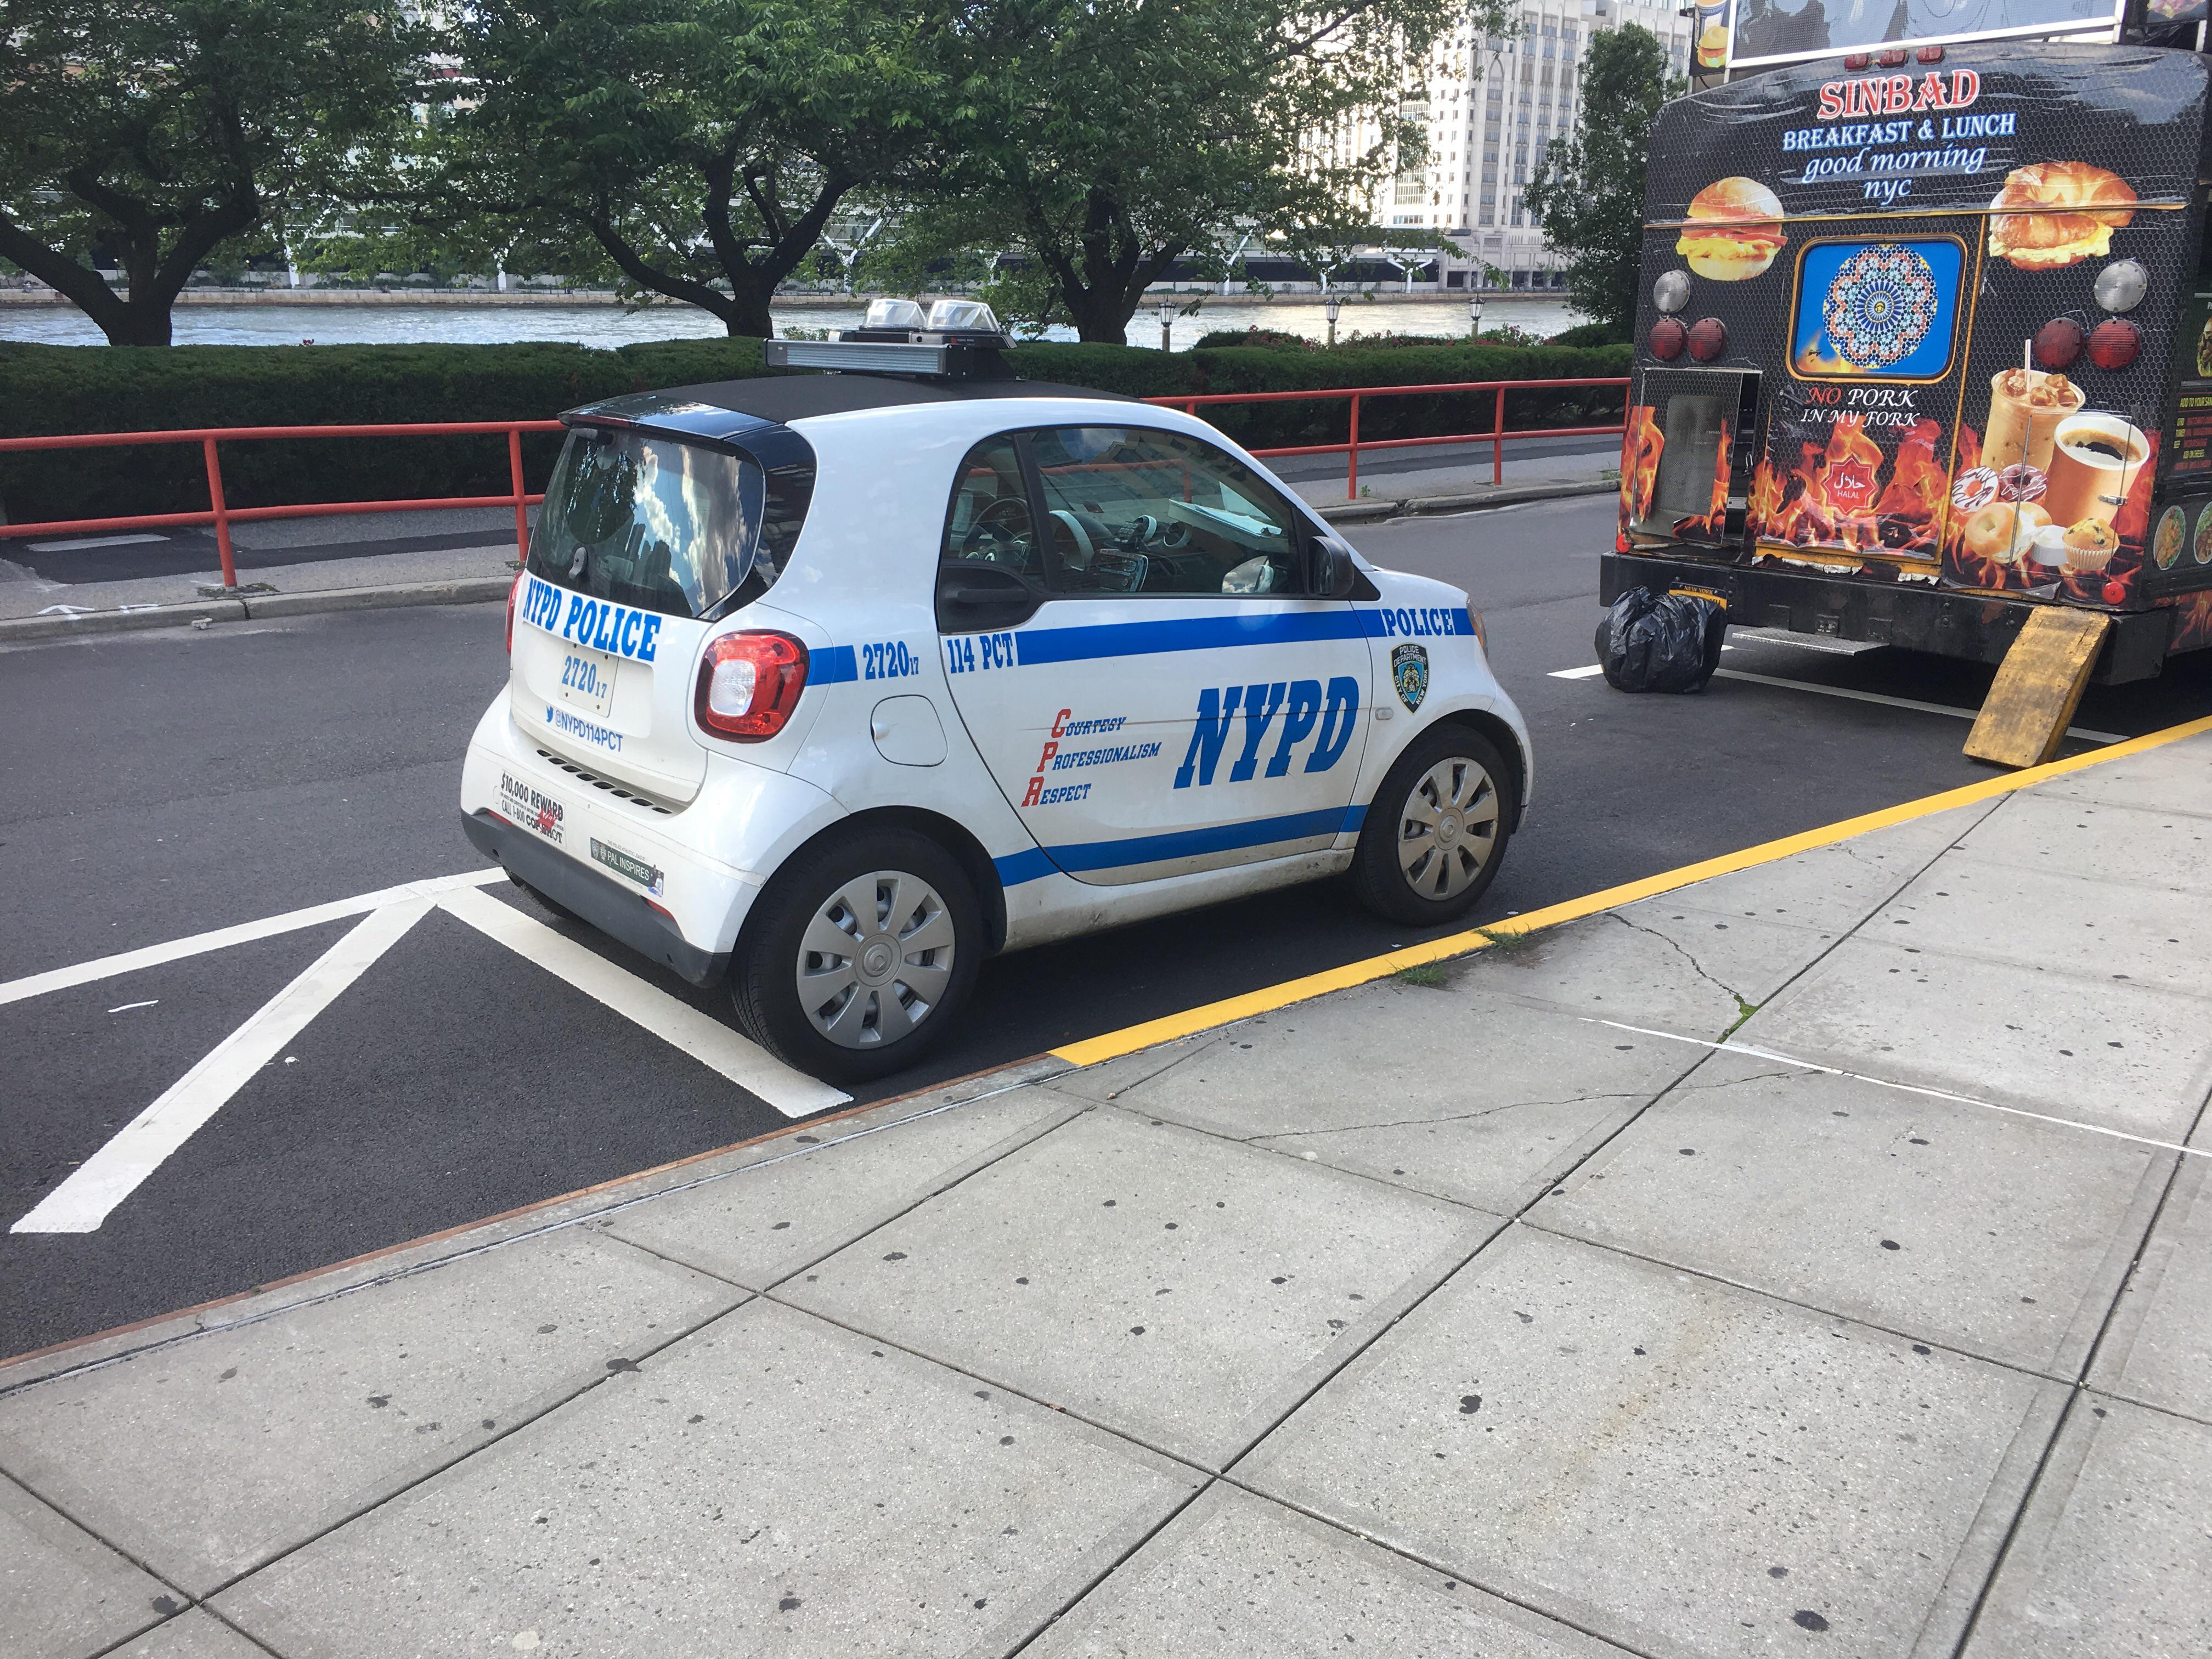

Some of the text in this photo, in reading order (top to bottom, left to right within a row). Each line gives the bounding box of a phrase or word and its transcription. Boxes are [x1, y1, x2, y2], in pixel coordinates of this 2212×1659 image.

[1816, 69, 1980, 119] SINBAD
[1782, 112, 2017, 151] BREAKFAST & LUNCH
[1802, 143, 1988, 184] good morning
[1864, 177, 1914, 206] nyc
[1805, 387, 1918, 407] NO PORK
[1800, 409, 1920, 428] IN MY FORK
[1833, 472, 1866, 489] حلال
[1837, 490, 1860, 499] HALAL
[523, 578, 662, 662] NYPD POLICE
[1381, 608, 1454, 636] POLICE
[863, 641, 919, 680] 2720 17
[947, 633, 1013, 674] 114 PCT
[1393, 653, 1426, 668] DEPARTMENT
[1400, 646, 1419, 654] POLICE
[562, 655, 607, 698] 2720 17
[1395, 675, 1408, 702] CITY OF
[1416, 689, 1425, 704] NEW
[555, 709, 623, 752] @NYPD114PCT
[1051, 709, 1127, 738] COURTESY
[1173, 676, 1359, 789] NYPD
[1036, 741, 1162, 772] PROFESSIONALISM
[501, 771, 529, 803] $10,000
[531, 789, 563, 821] REWARD
[1021, 776, 1092, 807] RESPECT
[502, 800, 512, 816] CALL
[513, 805, 525, 823] 1-800
[607, 850, 619, 865] PAL
[619, 857, 650, 881] INSPIRES
